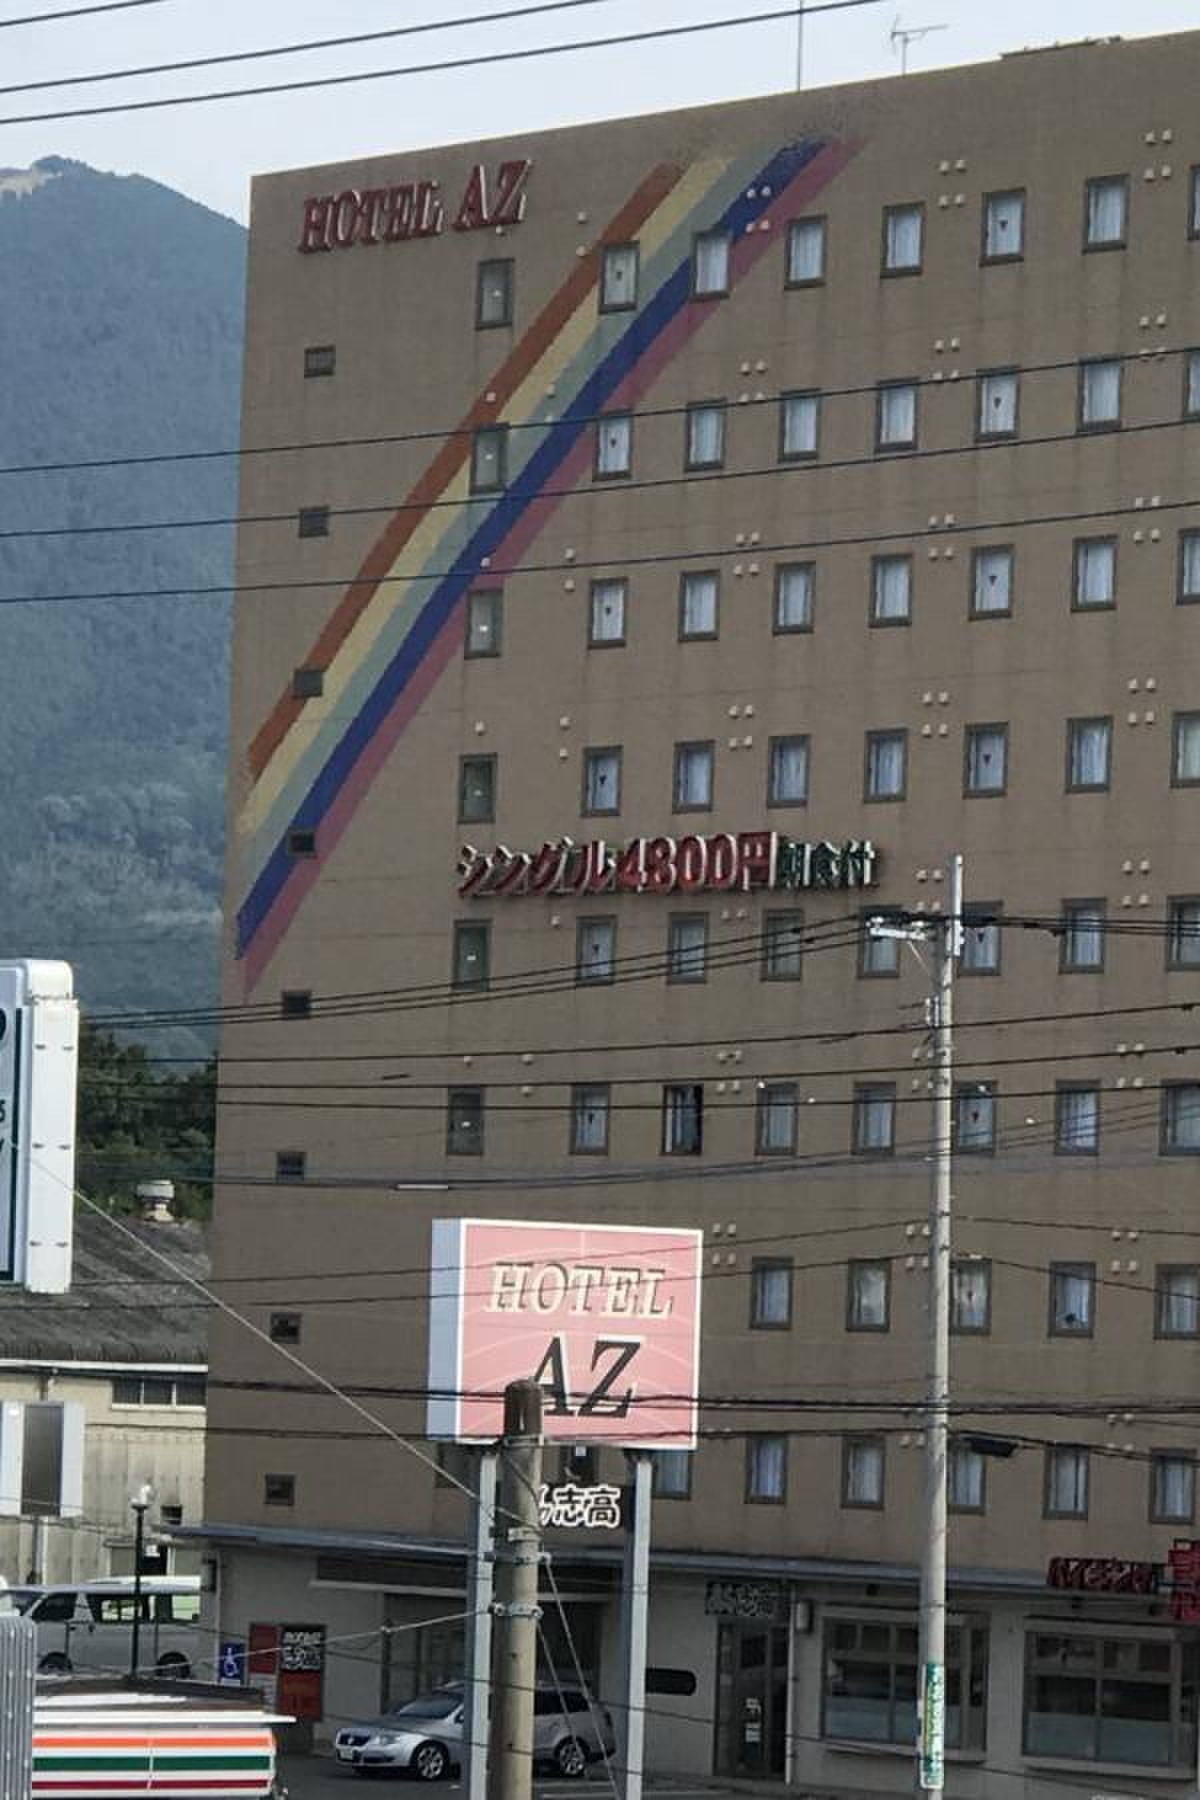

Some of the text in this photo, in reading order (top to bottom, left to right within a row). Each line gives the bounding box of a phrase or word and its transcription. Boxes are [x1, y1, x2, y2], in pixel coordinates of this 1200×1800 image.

[298, 159, 532, 253] HOTEL AZ
[484, 1260, 674, 1320] HOTEL
[530, 1329, 645, 1418] AZ
[538, 1483, 622, 1527] 志高
